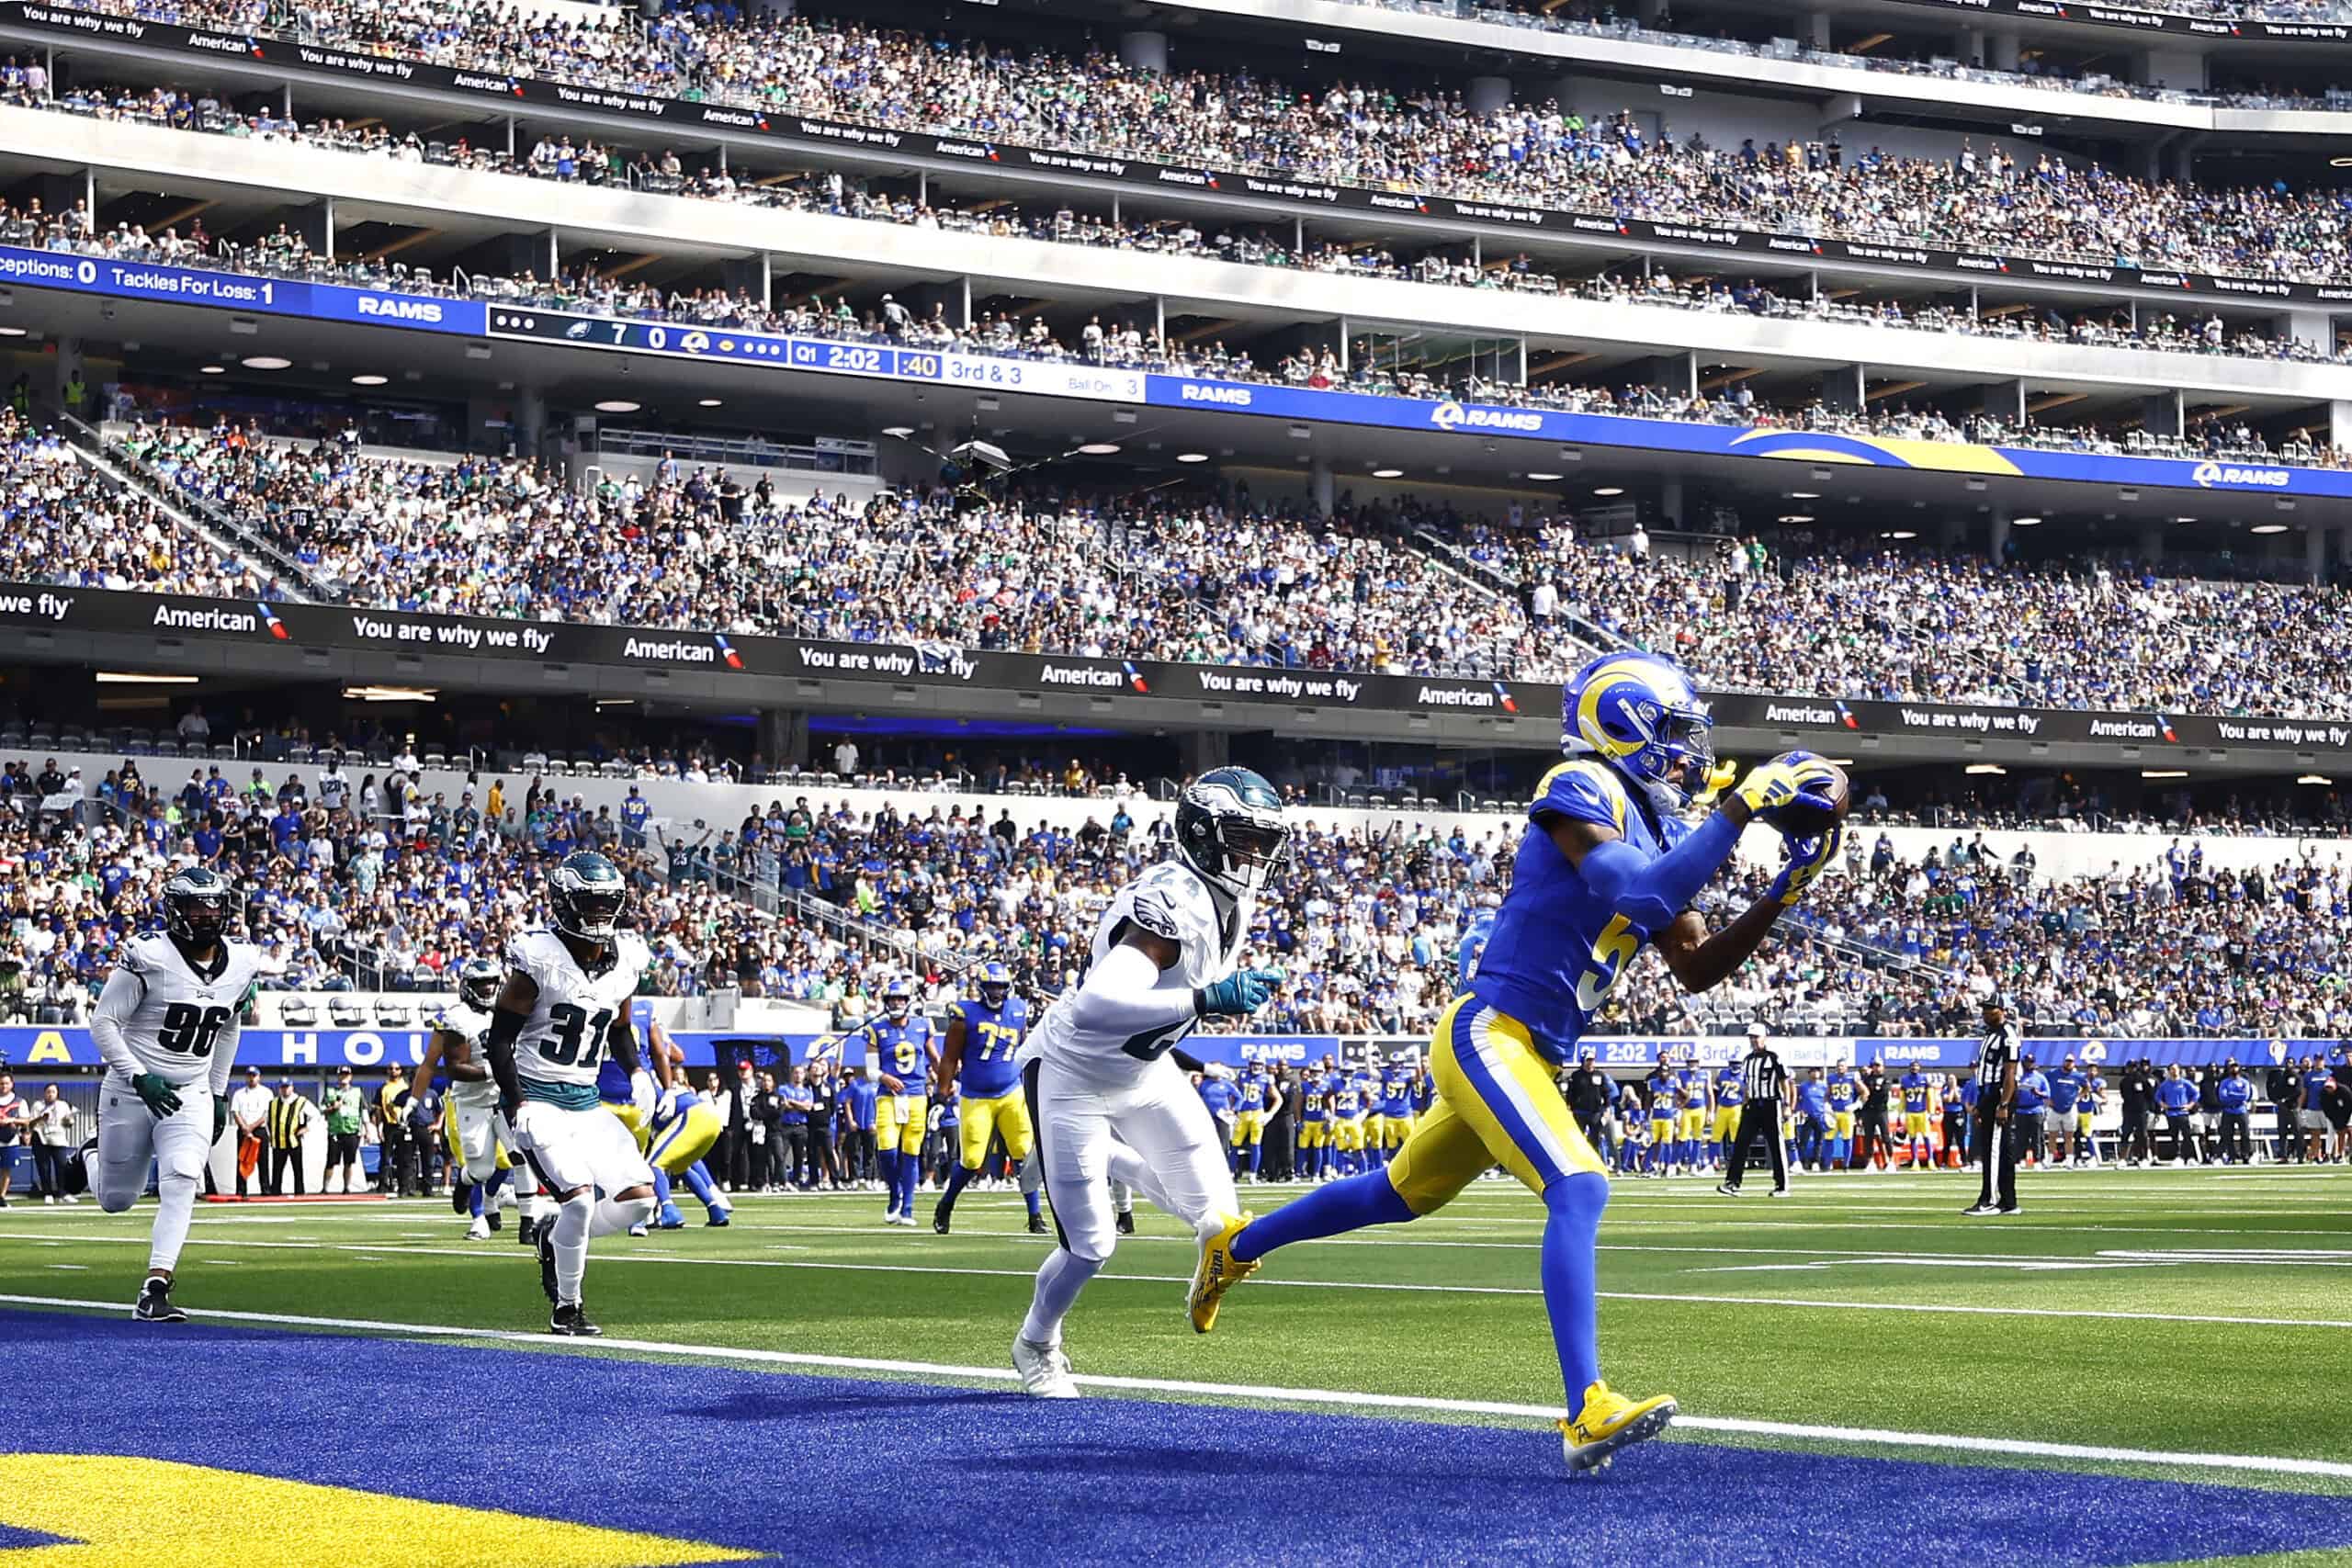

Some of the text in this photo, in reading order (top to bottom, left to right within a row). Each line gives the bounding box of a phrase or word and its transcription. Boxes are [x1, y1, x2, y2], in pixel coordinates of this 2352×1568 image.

[23, 6, 143, 38] You are why we fly
[189, 35, 246, 52] American
[300, 50, 413, 78] You are why we fly
[455, 75, 508, 91] American
[559, 88, 664, 114] You are why we fly
[703, 110, 754, 126] American
[801, 121, 900, 147] You are why we fly
[936, 142, 986, 157] American
[1029, 152, 1125, 175] You are why we fly
[1159, 170, 1206, 184] American
[1247, 179, 1338, 201] You are why we fly
[1371, 195, 1416, 209] American
[1455, 204, 1543, 223] You are why we fly
[1574, 218, 1616, 231] American
[78, 261, 96, 284] 0
[112, 267, 273, 304] Tackles For Loss: 1
[358, 297, 442, 322] RAMS
[611, 324, 667, 349] 7 0
[797, 347, 880, 372] Q1 2:02
[903, 355, 937, 377] :40
[951, 361, 1022, 384] 3rd & 3
[1069, 377, 1091, 391] Ball
[1127, 379, 1138, 396] 3
[1182, 384, 1252, 405] RAMS
[1466, 409, 1543, 431] RAMS
[2222, 467, 2290, 486] RAMS
[0, 592, 68, 619] we fly
[154, 605, 255, 631] American
[354, 616, 551, 652] You are why we fly
[624, 637, 714, 661] American
[799, 647, 834, 667] You
[839, 654, 869, 669] are
[874, 653, 913, 675] why
[950, 656, 974, 679] fly
[1041, 665, 1122, 686] American
[1199, 672, 1360, 701] You are why we fly
[1419, 687, 1493, 706] American
[1766, 705, 1836, 723] American
[1902, 709, 2037, 734] You are why we fly
[2090, 720, 2155, 737] American
[2219, 724, 2346, 746] You are why we fly
[1577, 911, 1638, 1011] 5
[158, 1002, 232, 1057] 96
[539, 1002, 613, 1068] 31
[978, 1021, 1019, 1062] 77
[1240, 1044, 1306, 1060] RAMS
[1607, 1043, 1646, 1062] 2:02
[895, 1042, 917, 1075] 9
[1702, 1045, 1728, 1061] 3rd
[1884, 1045, 1941, 1061] RAMS
[1719, 1080, 1740, 1100] 72
